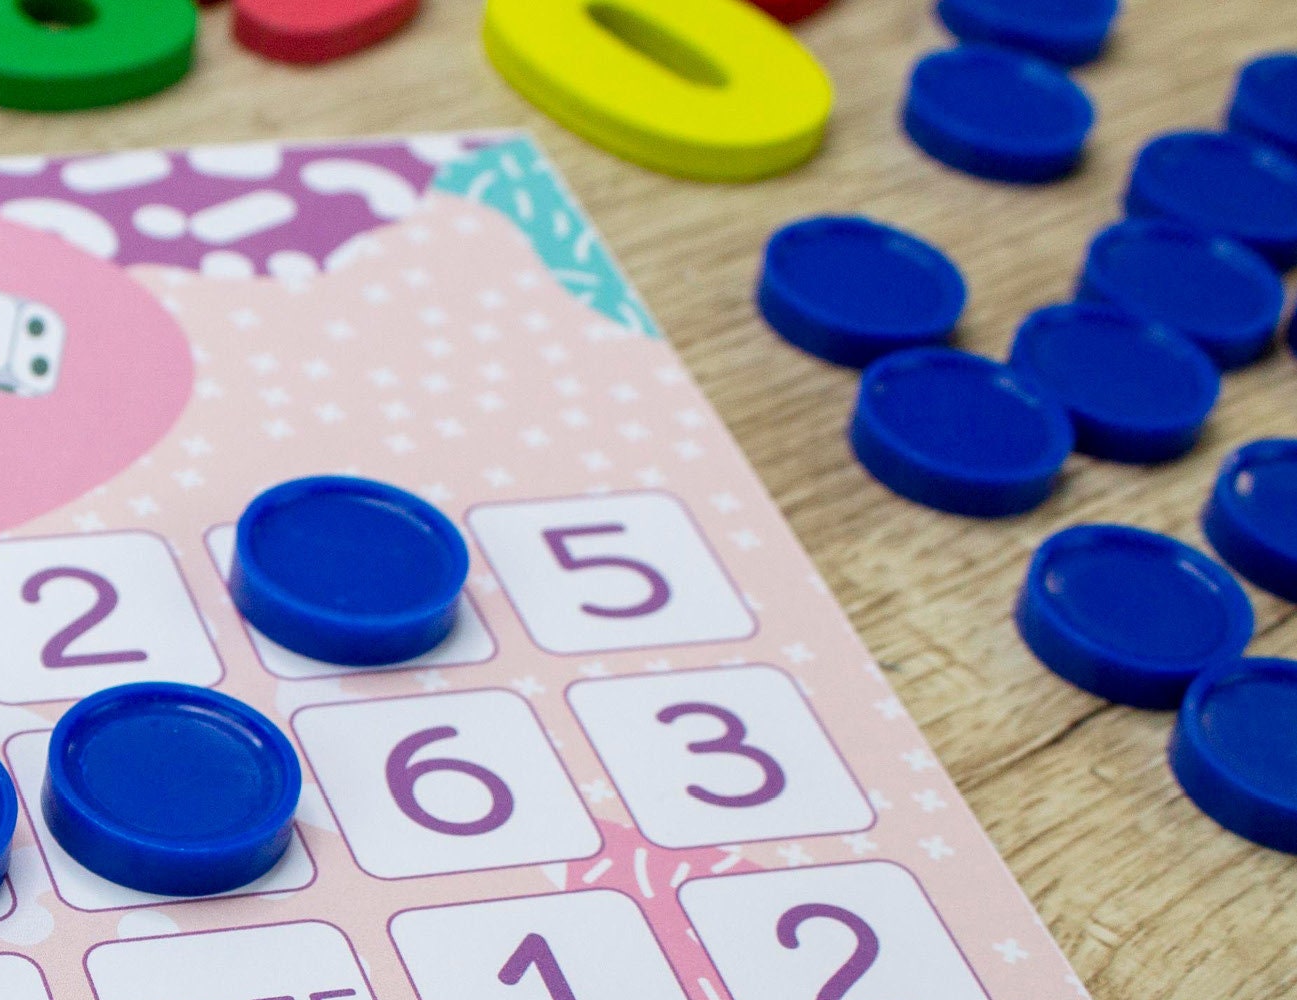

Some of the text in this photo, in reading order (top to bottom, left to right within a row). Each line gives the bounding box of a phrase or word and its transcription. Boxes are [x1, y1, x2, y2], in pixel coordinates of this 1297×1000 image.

[23, 568, 148, 667] 2
[544, 526, 669, 618] 5
[386, 727, 513, 836] 6
[657, 703, 785, 807] 3
